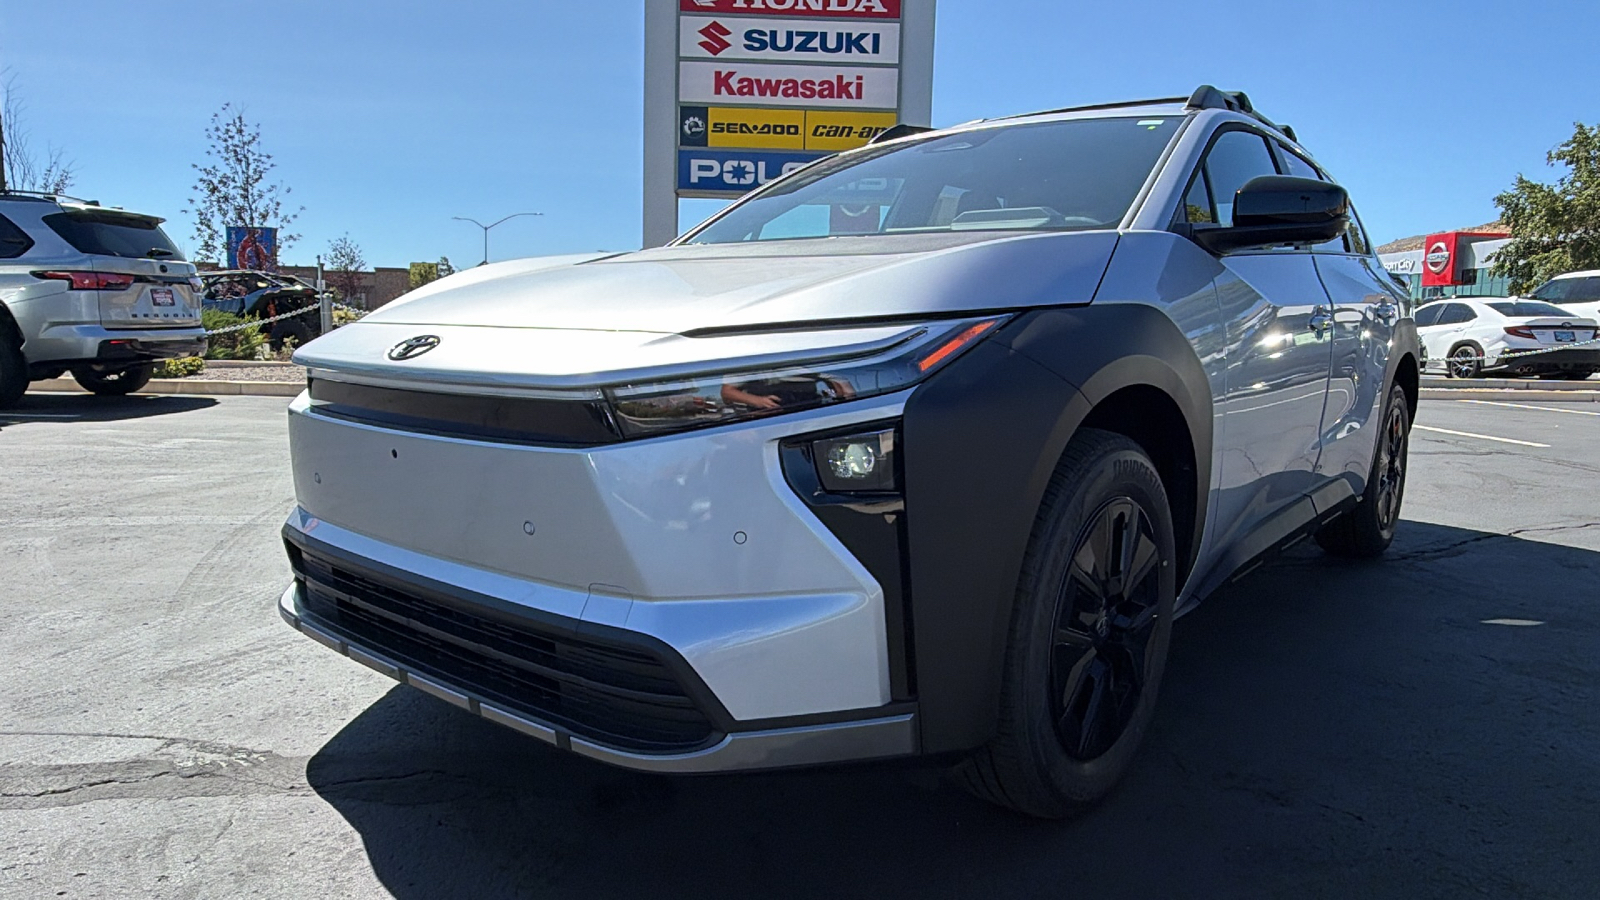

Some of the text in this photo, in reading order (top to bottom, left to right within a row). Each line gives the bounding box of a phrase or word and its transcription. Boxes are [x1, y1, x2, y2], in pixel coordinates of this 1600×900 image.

[743, 29, 880, 55] SUZUKI
[714, 71, 863, 100] Kawasaki
[1399, 259, 1415, 273] City
